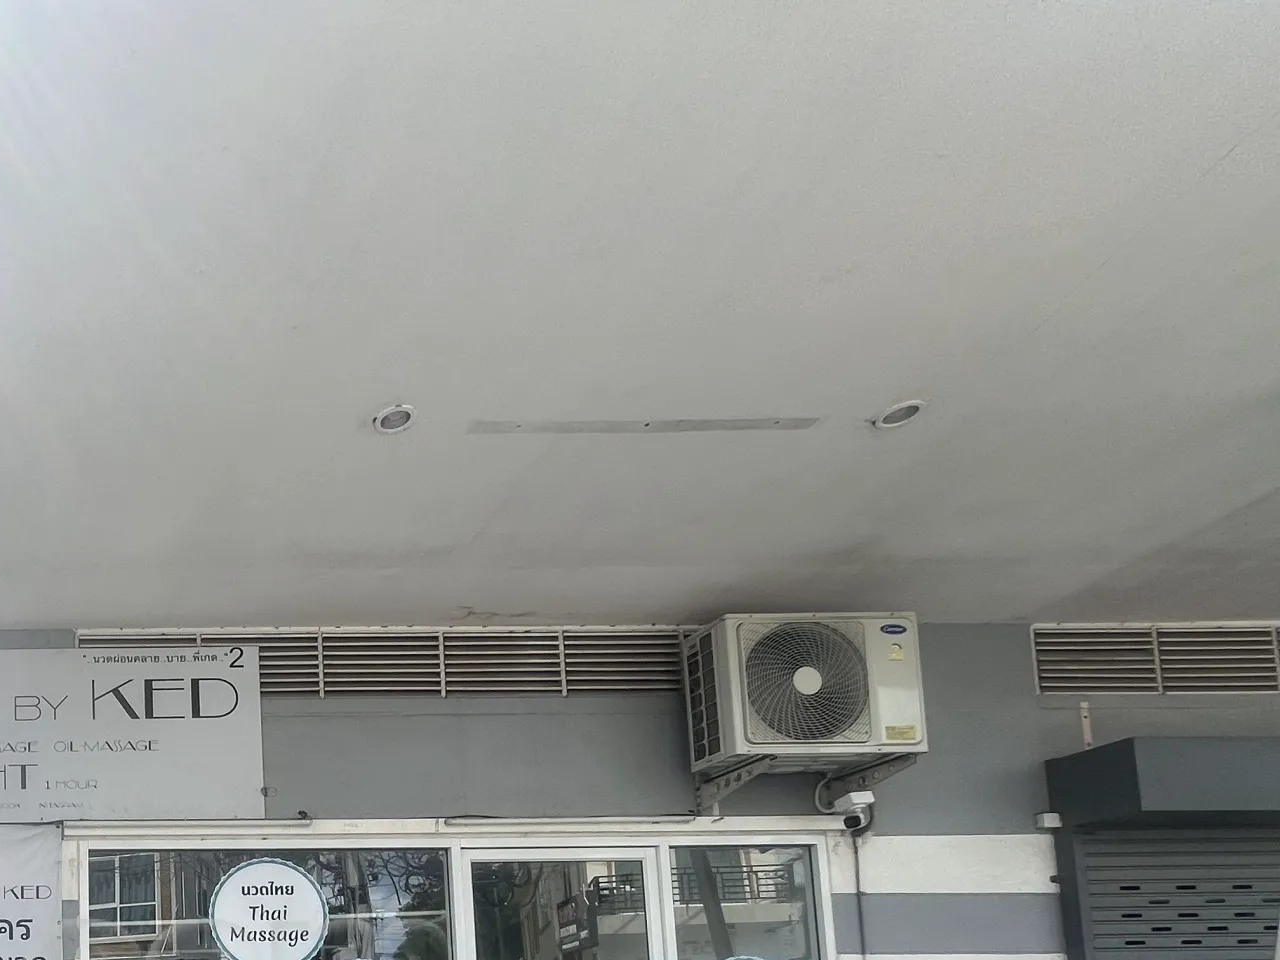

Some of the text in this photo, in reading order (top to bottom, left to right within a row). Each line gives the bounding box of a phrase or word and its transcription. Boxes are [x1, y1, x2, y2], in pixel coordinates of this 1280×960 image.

[14, 695, 69, 721] BY
[91, 677, 239, 721] KED
[55, 779, 98, 790] HOUR
[3, 885, 53, 900] KED
[241, 881, 294, 896] นวดไทย
[249, 904, 288, 921] Thai
[230, 926, 309, 947] Massage
